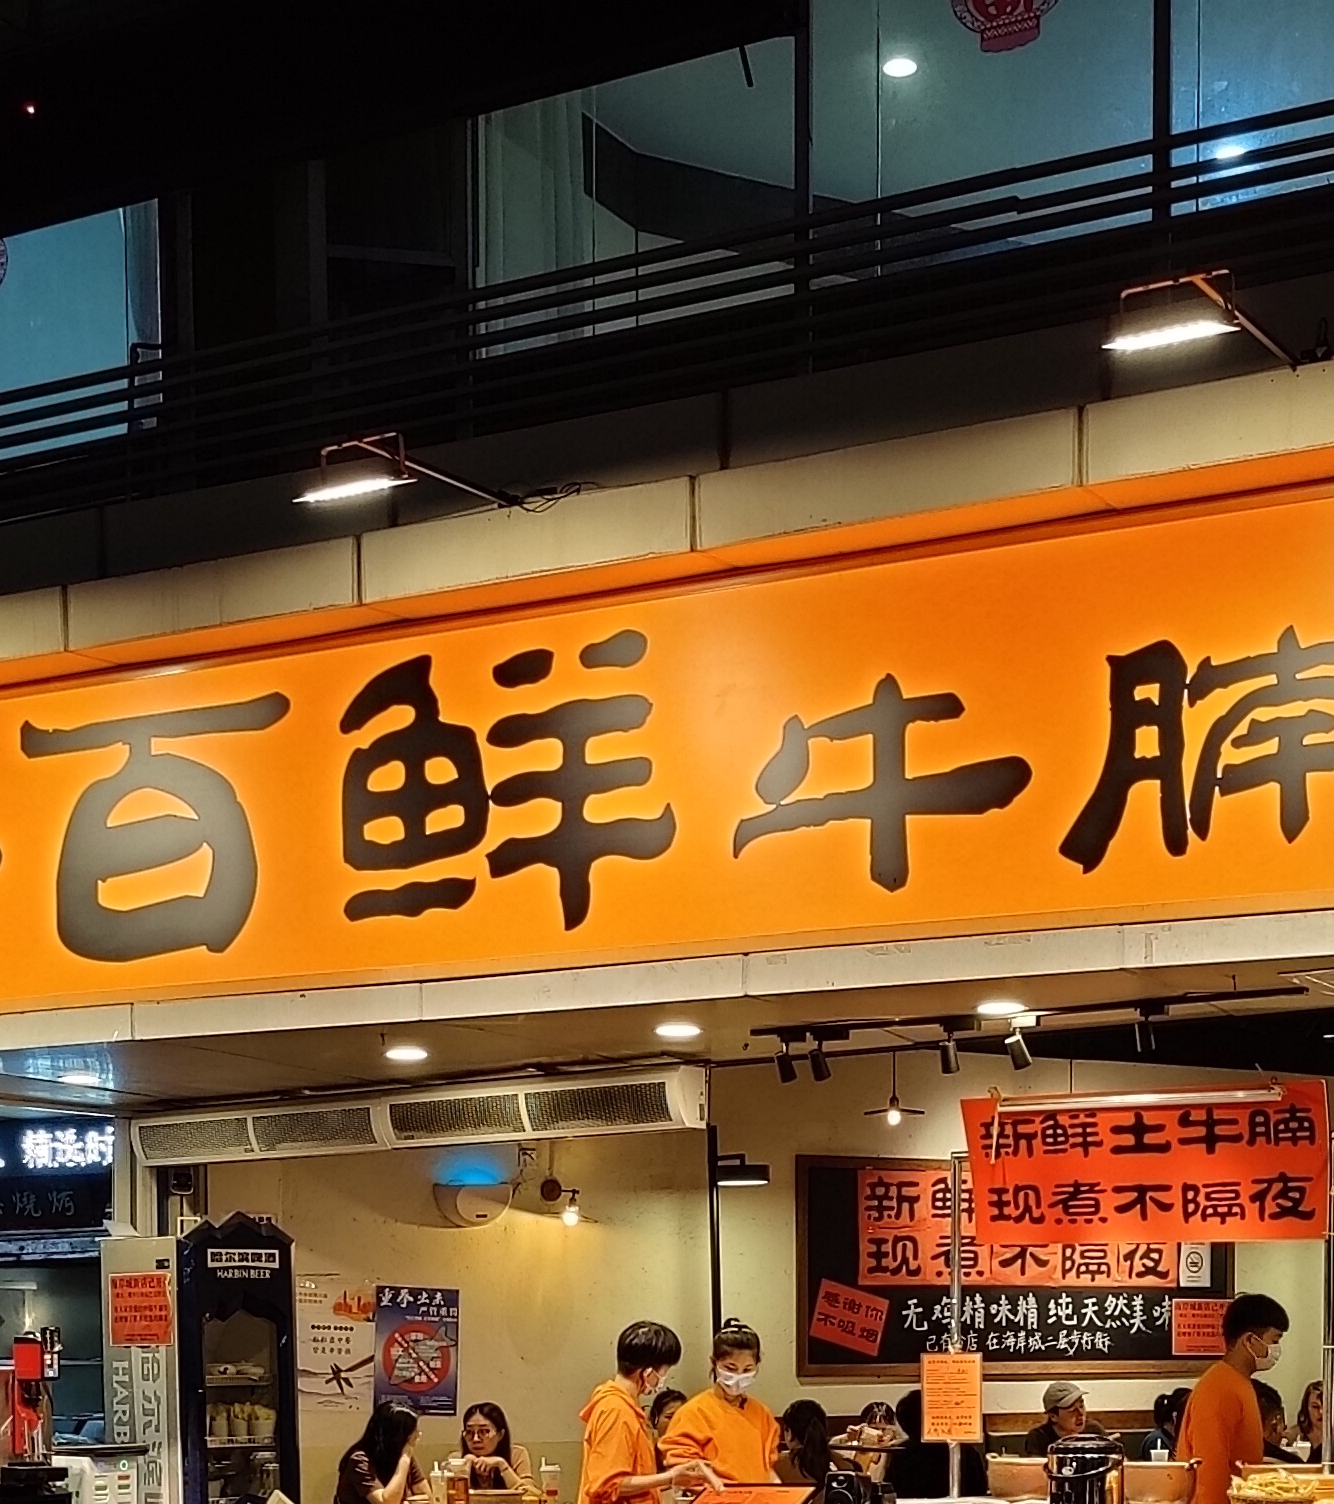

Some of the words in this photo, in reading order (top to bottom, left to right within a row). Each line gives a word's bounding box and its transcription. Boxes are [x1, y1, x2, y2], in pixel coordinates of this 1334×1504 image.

[979, 1102, 1318, 1160] 新鲜土牛腩
[986, 1171, 1318, 1226] 现煮不隔夜
[216, 1268, 249, 1279] HARBIN
[249, 1269, 271, 1279] BEER
[865, 1234, 1172, 1280] 现煮不隔夜
[822, 1290, 884, 1322] 感谢你
